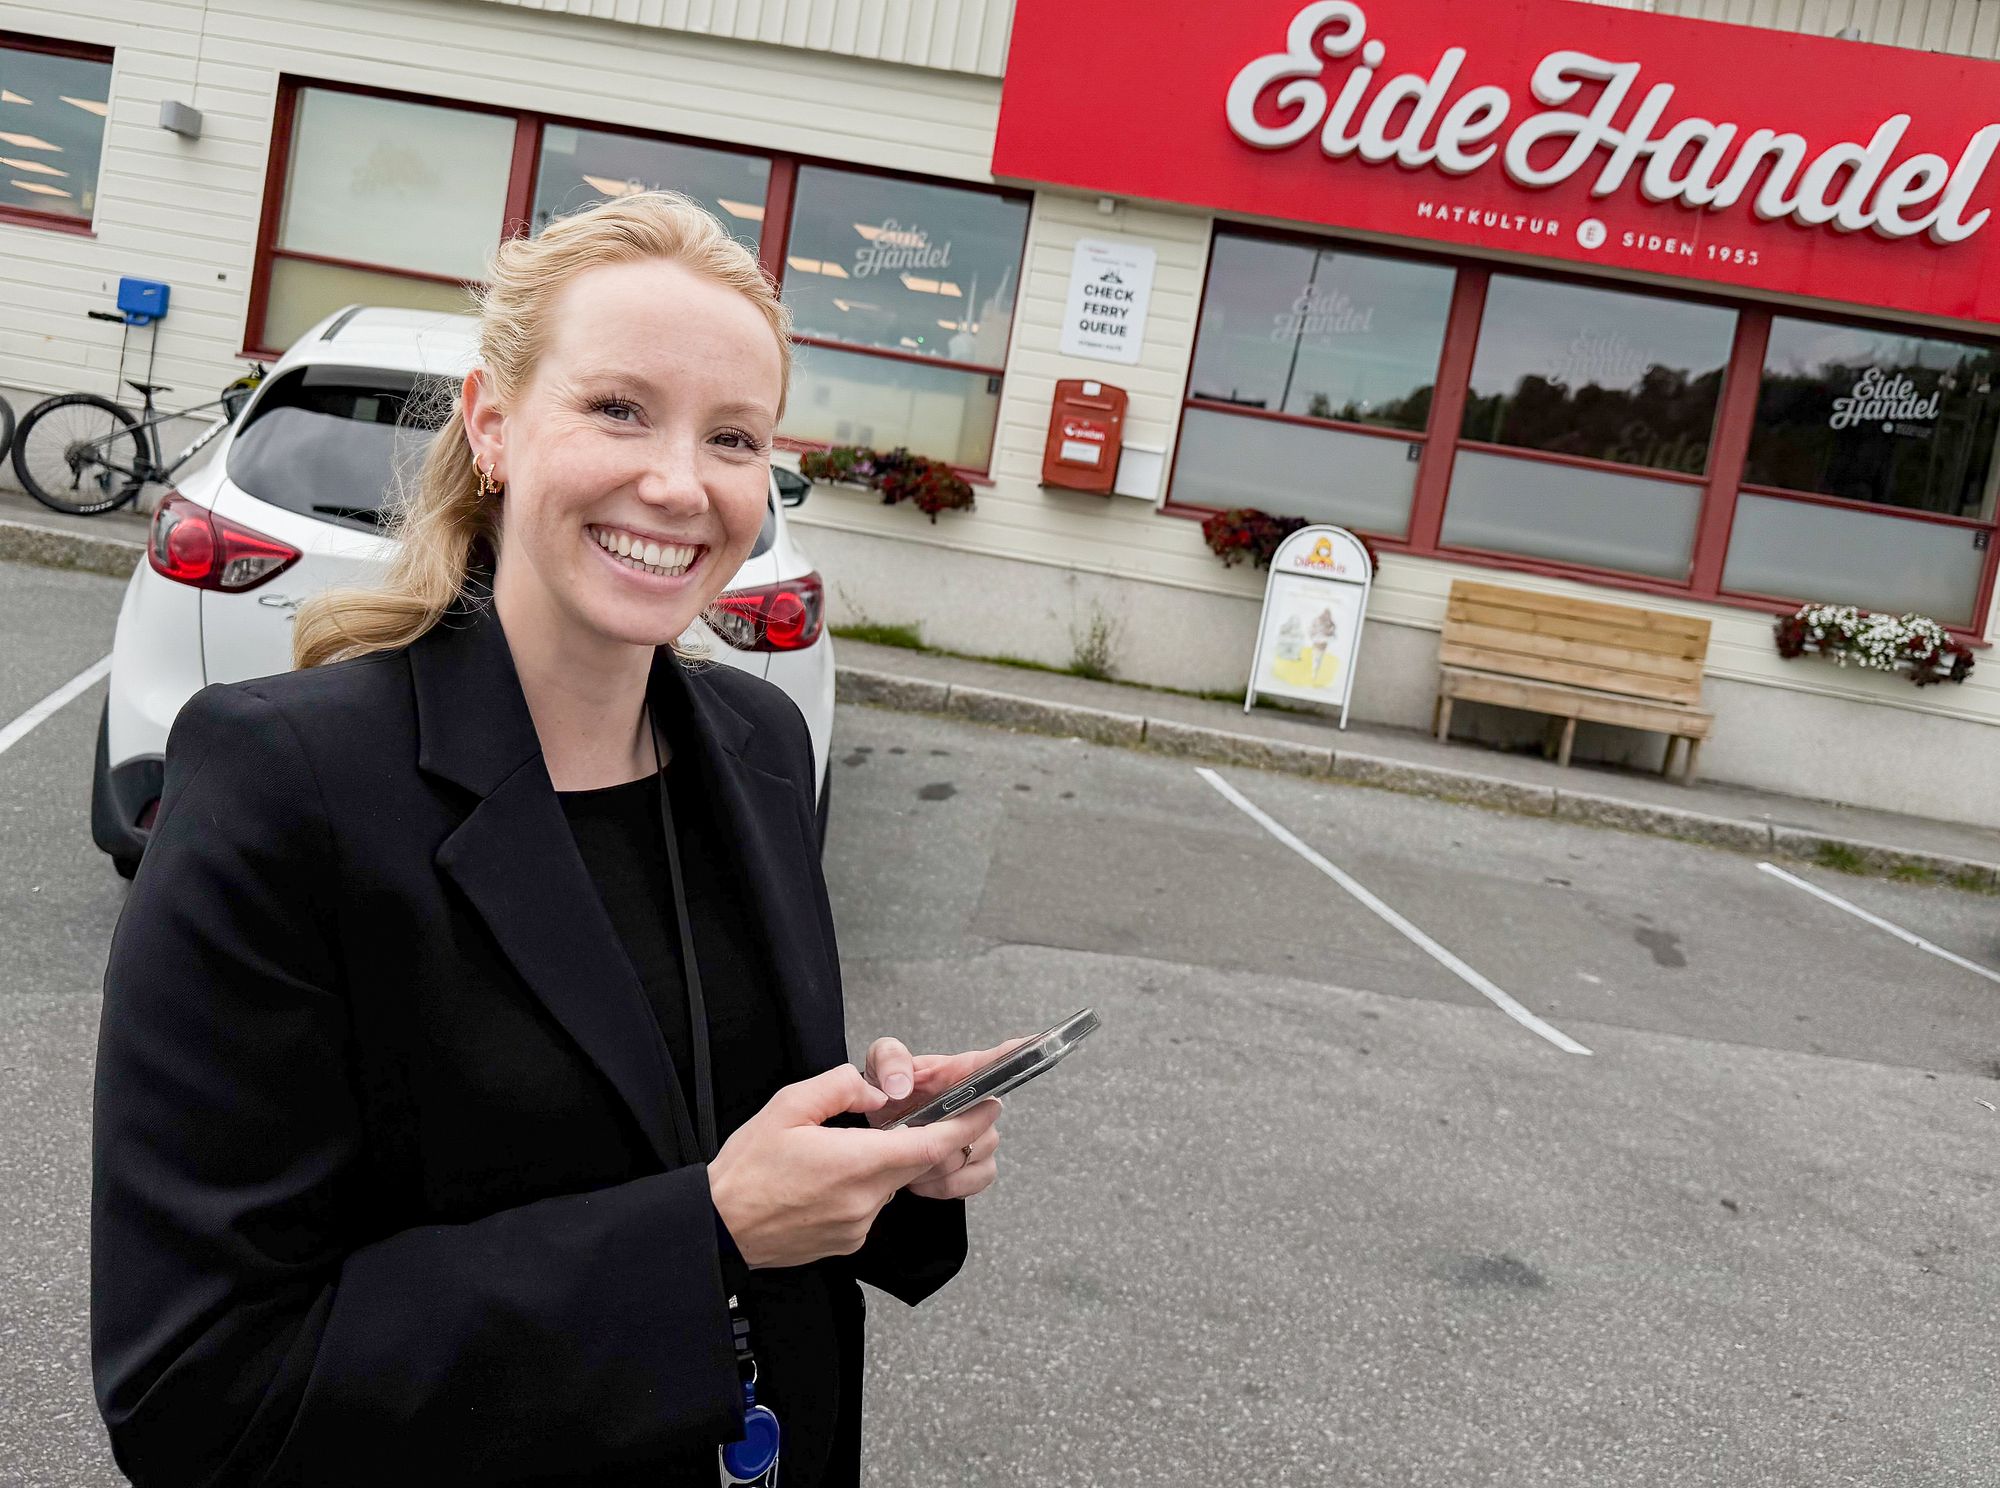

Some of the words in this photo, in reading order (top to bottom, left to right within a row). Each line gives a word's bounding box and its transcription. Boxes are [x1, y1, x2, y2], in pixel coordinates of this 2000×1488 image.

[1226, 0, 1511, 175] Eide
[1504, 50, 2000, 245] Handel
[1417, 202, 1560, 237] MATKULTUR
[1622, 231, 1695, 257] SIDEN
[1707, 244, 1760, 267] 1953
[853, 241, 951, 279] Handel
[1083, 284, 1135, 303] CHECK
[1083, 302, 1129, 319] FERRY
[1079, 320, 1128, 338] QUEUE
[1852, 367, 1914, 400] Eide
[1829, 391, 1940, 430] Handel
